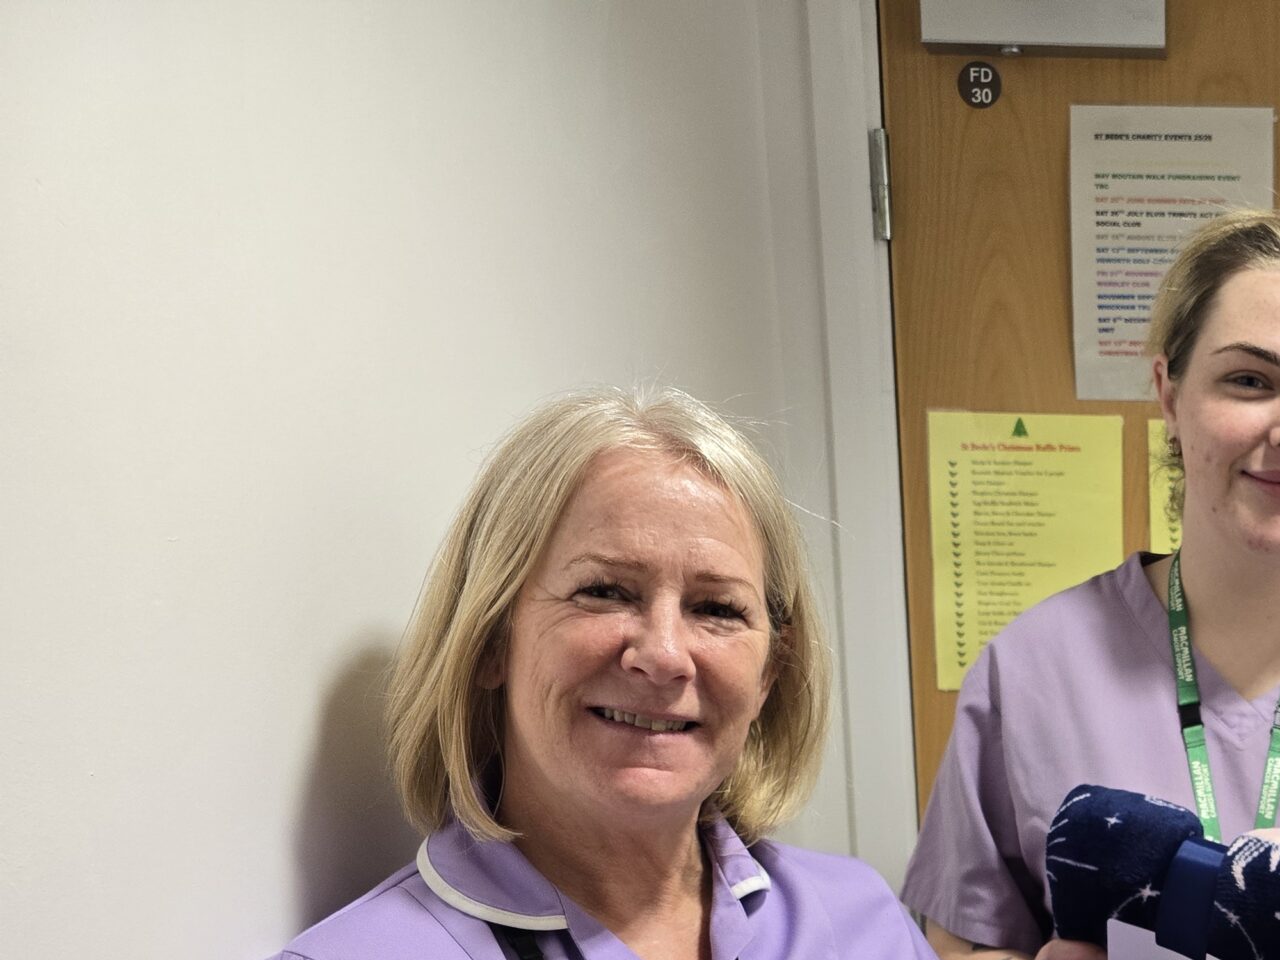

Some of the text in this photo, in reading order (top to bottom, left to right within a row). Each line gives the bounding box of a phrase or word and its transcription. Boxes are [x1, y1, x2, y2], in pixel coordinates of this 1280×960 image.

[970, 67, 992, 83] FD
[971, 88, 992, 103] 30
[1131, 133, 1162, 141] CHARITY
[1178, 626, 1194, 682] MACMILLAN
